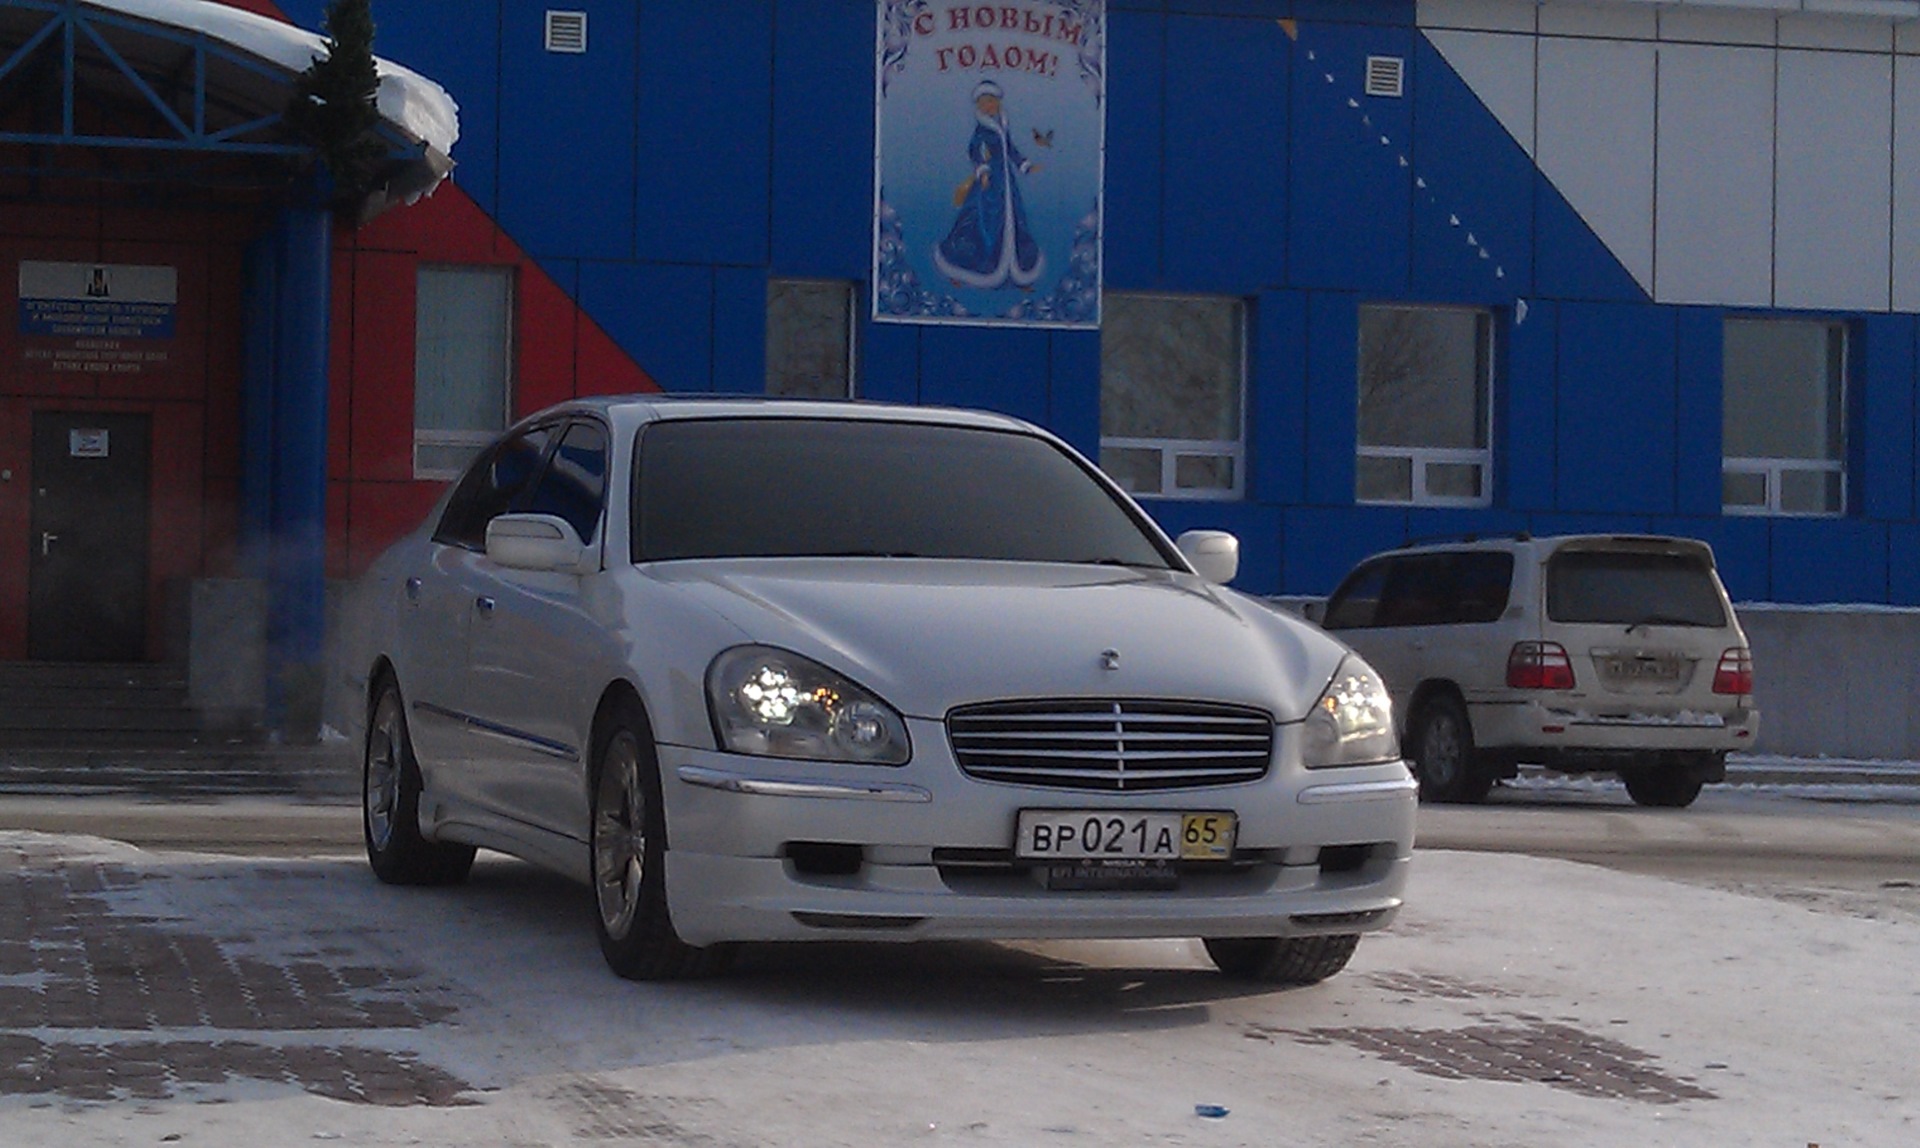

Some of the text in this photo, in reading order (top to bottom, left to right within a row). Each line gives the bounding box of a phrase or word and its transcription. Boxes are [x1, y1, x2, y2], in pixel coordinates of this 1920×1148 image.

[914, 7, 1082, 46] С НОВЫМ
[936, 44, 1058, 77] ГОДОМ!
[1185, 818, 1218, 844] 65
